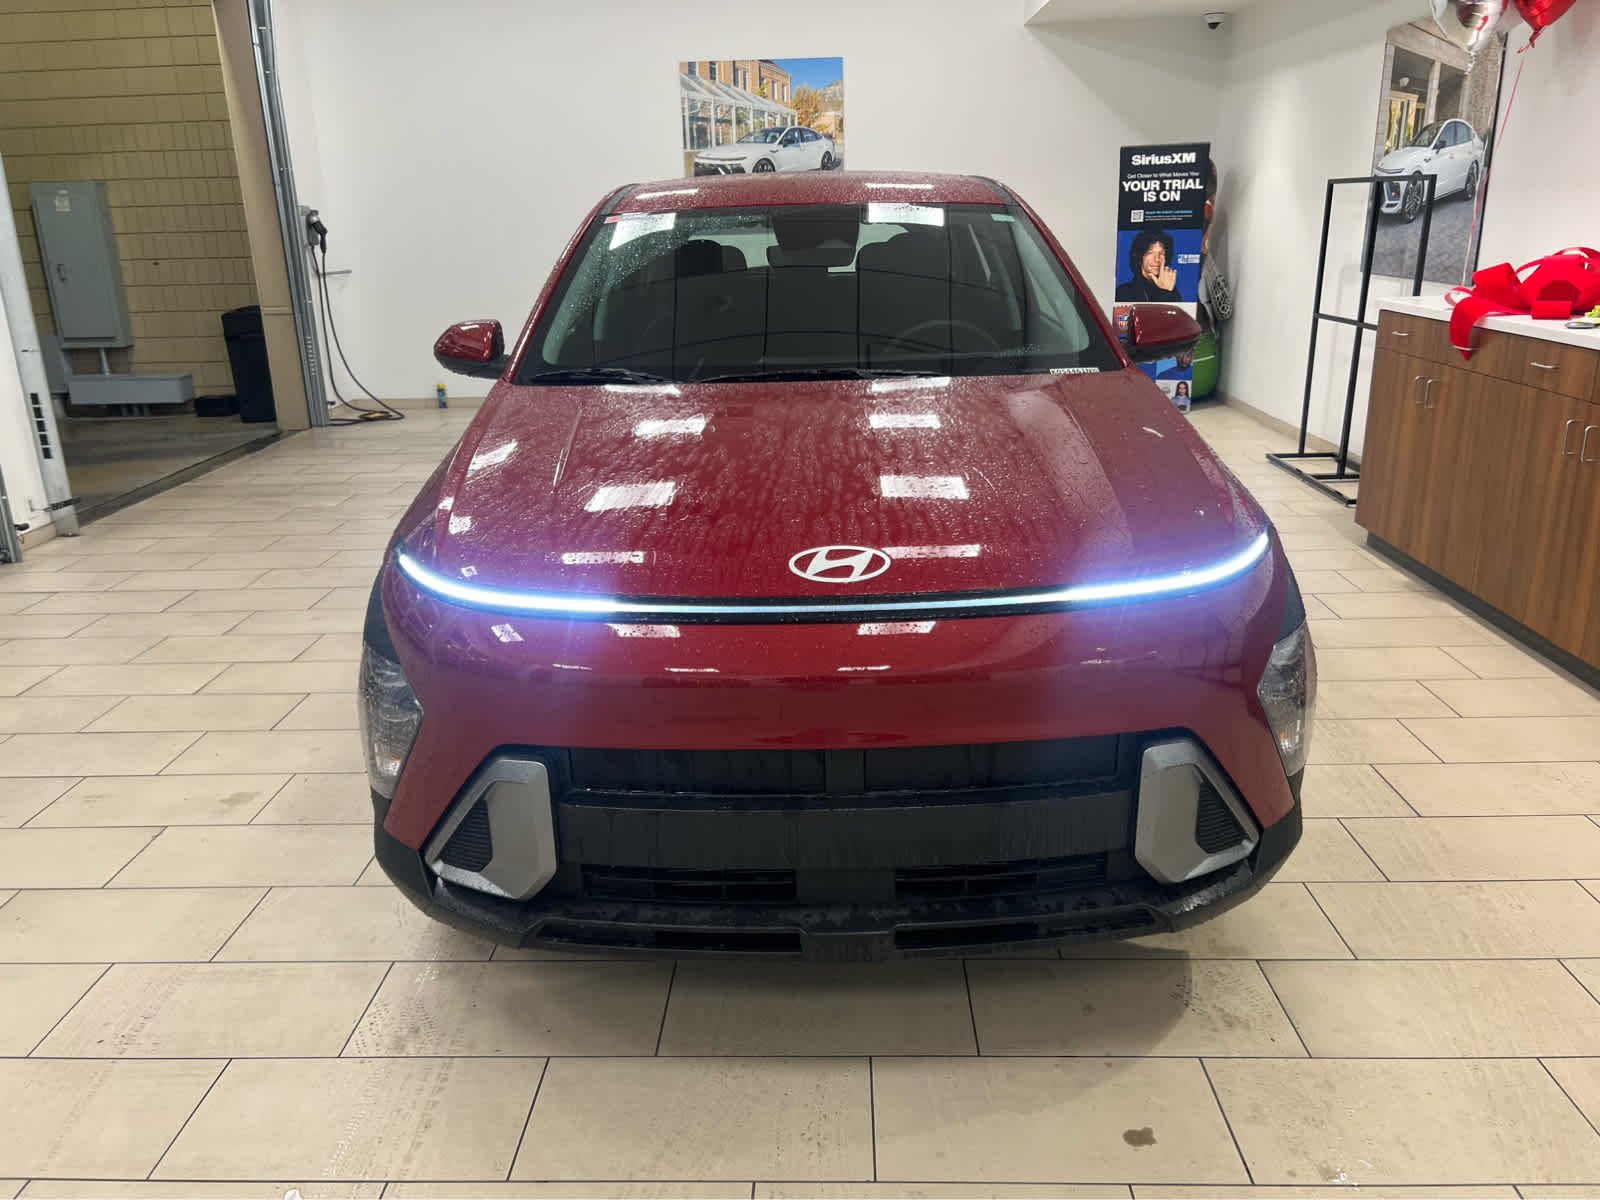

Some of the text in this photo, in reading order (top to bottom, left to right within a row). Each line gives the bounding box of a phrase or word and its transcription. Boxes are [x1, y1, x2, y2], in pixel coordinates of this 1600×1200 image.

[1132, 152, 1196, 165] SiriusXM
[1122, 178, 1203, 191] YOUR TRIAL
[1144, 191, 1181, 202] IS ON
